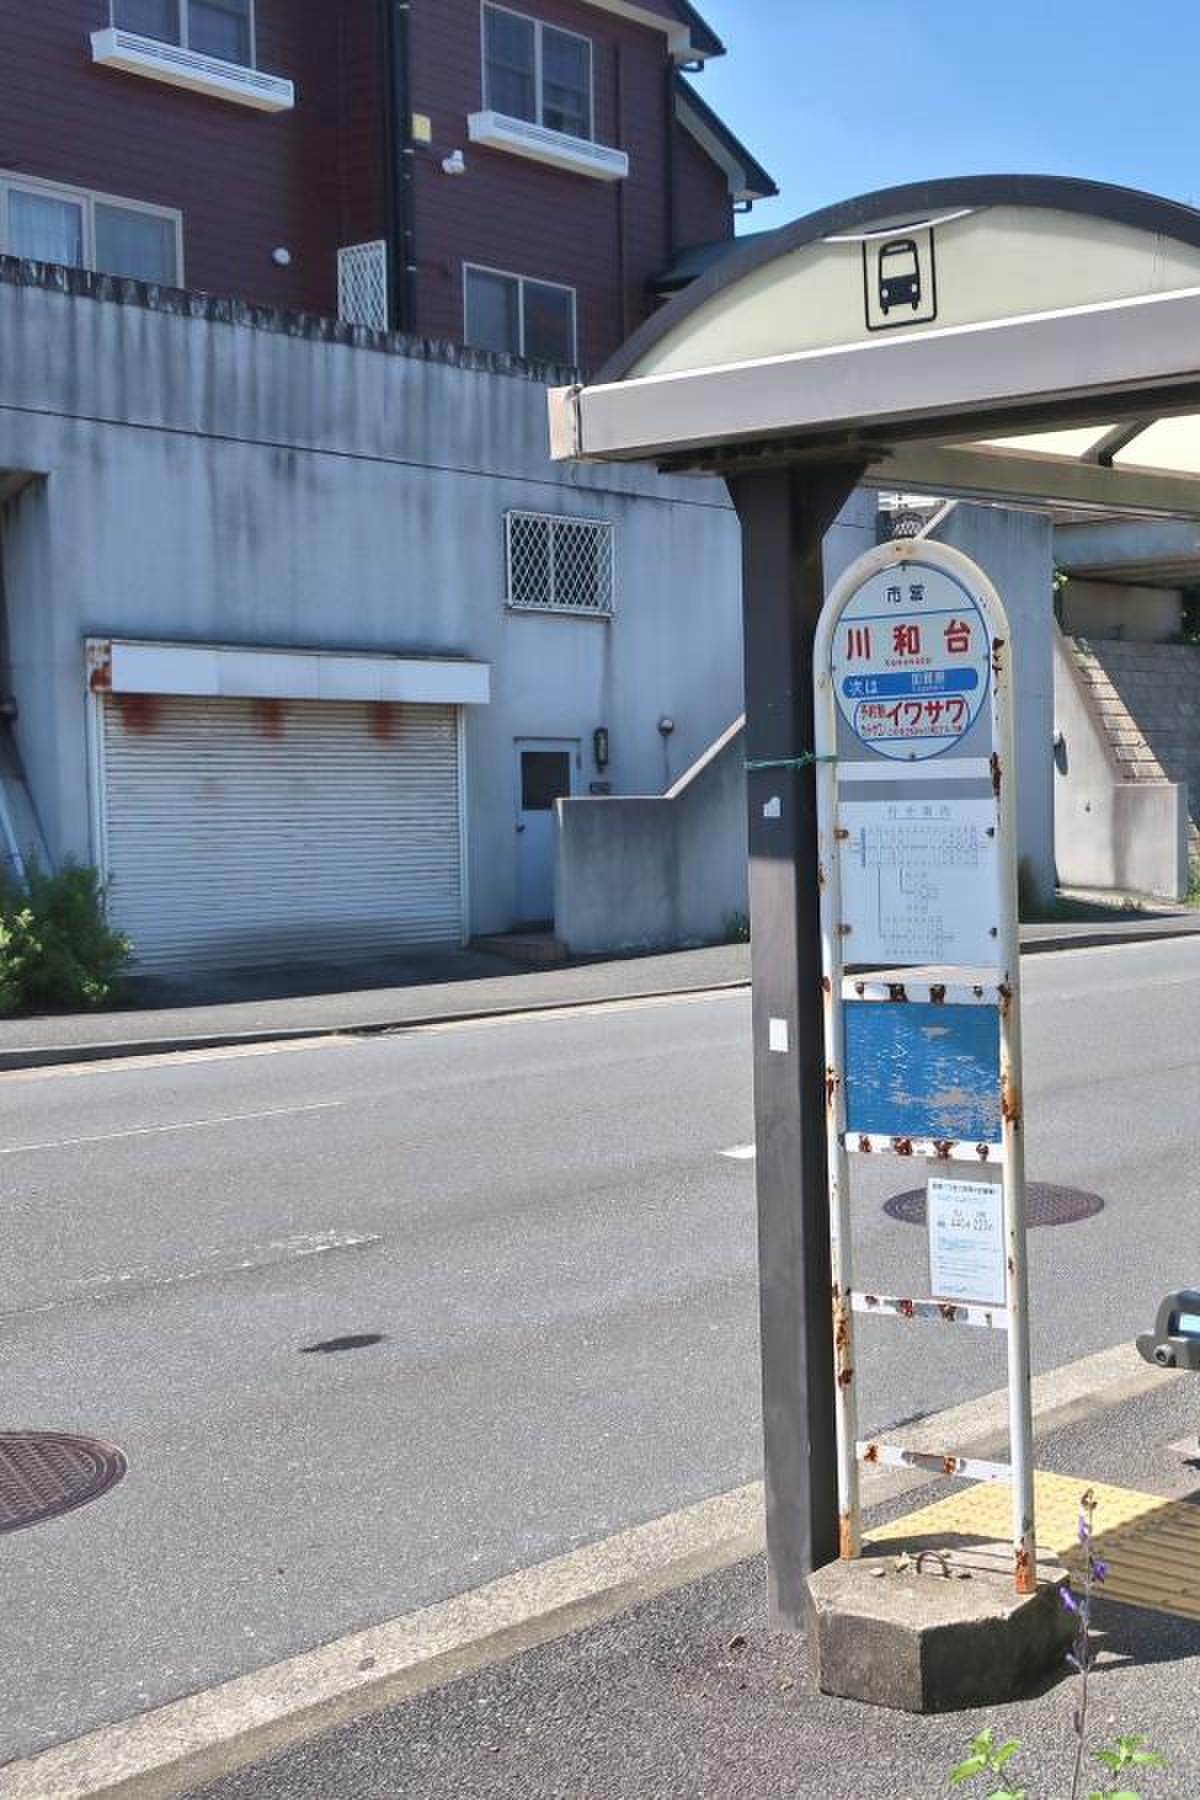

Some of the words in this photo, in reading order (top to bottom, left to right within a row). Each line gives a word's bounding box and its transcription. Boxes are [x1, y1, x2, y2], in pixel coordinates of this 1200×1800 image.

[887, 584, 925, 603] 市営
[847, 619, 971, 661] 川和台
